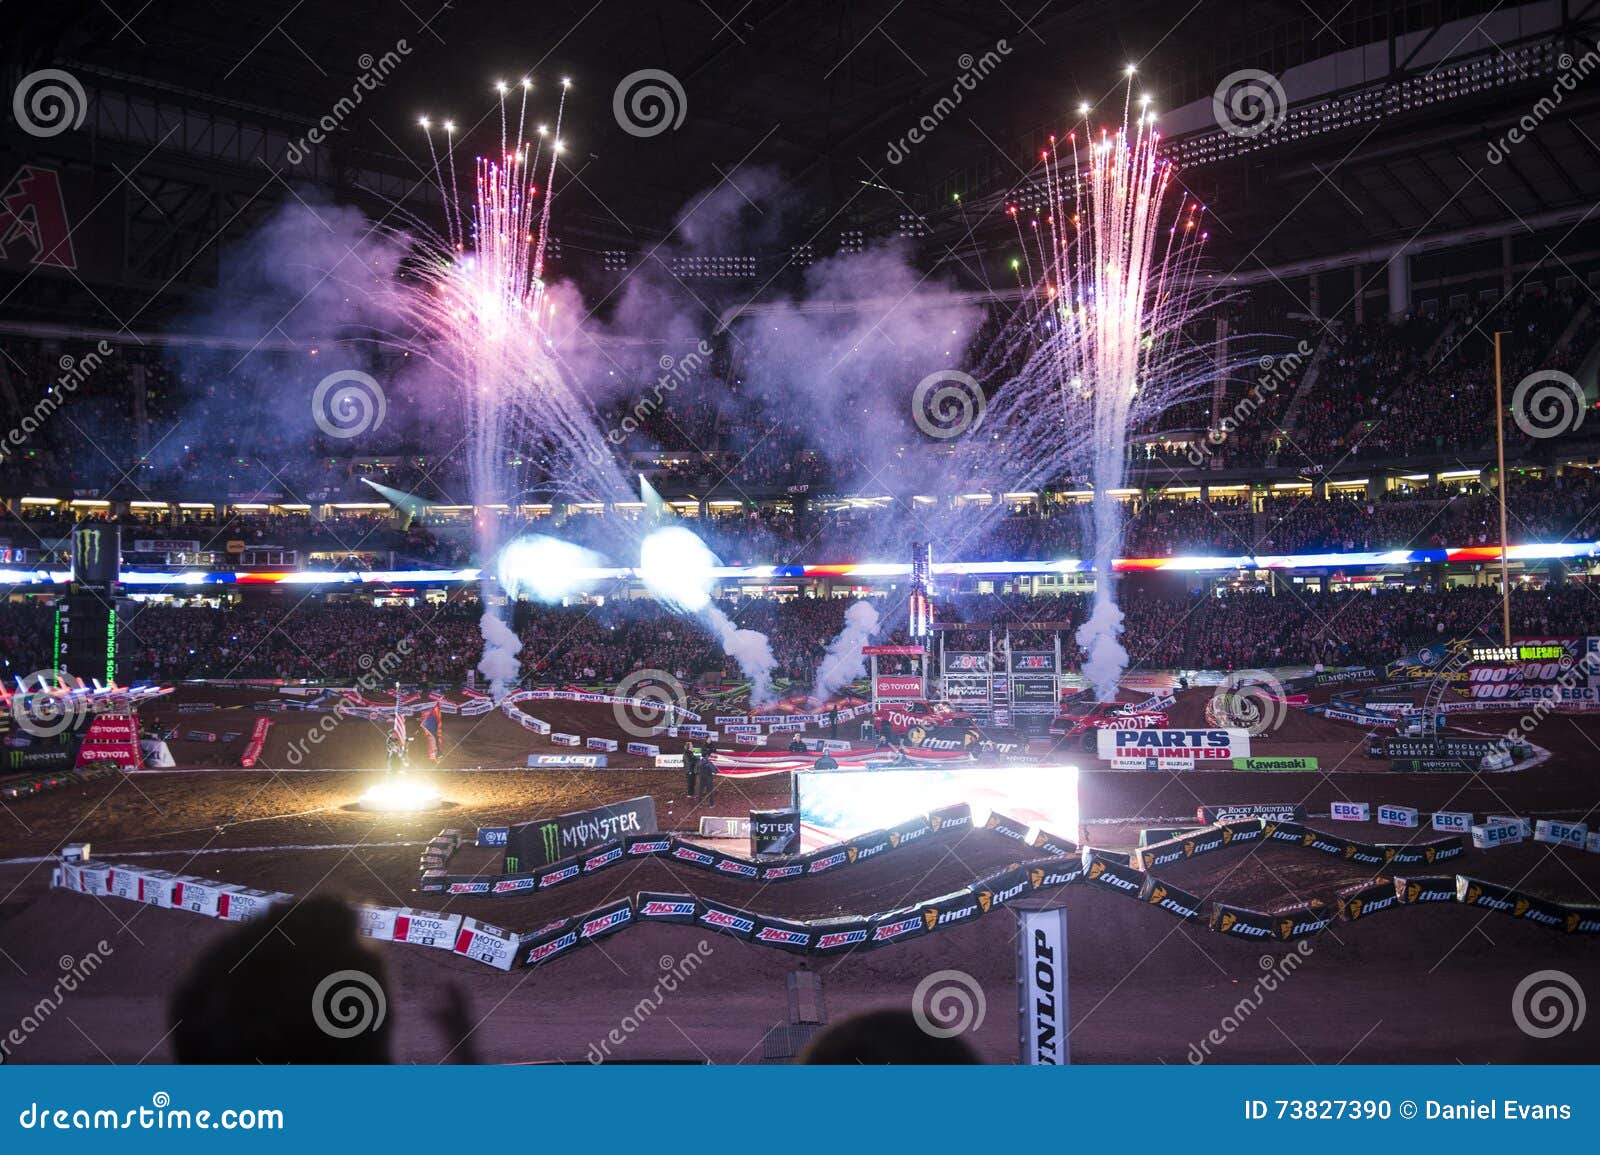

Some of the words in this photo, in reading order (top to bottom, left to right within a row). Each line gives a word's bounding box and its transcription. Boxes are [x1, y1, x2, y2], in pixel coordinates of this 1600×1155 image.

[1472, 647, 1518, 655] NUCLEAR
[1469, 667, 1524, 682] 100%
[890, 682, 920, 690] TOYOTA
[1470, 683, 1524, 698] 100%
[1522, 687, 1554, 699] EBC
[1561, 687, 1594, 699] EBC
[921, 737, 961, 750] thor
[1116, 730, 1232, 747] PARTS
[96, 751, 130, 759] TOYOTA
[1116, 747, 1232, 759] UNLIMITED
[1246, 758, 1307, 770] Kawasaki
[1228, 805, 1252, 814] ROCKY
[1253, 804, 1294, 813] MOUNTAIN
[1334, 804, 1360, 815] EBC
[1380, 809, 1407, 821] EBC
[940, 813, 972, 830] thor
[1435, 815, 1463, 826] EBC
[900, 826, 930, 843] thor
[995, 824, 1026, 841] thor
[1231, 830, 1261, 841] thor
[1272, 830, 1302, 841] thor
[1488, 825, 1518, 841] EBC
[1551, 825, 1581, 842] EBC
[628, 840, 671, 855] AMSOIL
[857, 842, 888, 860] thor
[1194, 840, 1222, 853] thor
[1311, 839, 1341, 854] thor
[1435, 846, 1463, 860] thor
[583, 847, 623, 871] AMSOIL
[672, 846, 714, 865] AMSOIL
[808, 851, 847, 872] AMSOIL
[1154, 851, 1183, 865] thor
[1353, 852, 1382, 864] thor
[1393, 851, 1423, 862] thor
[715, 859, 757, 876] AMSOIL
[762, 865, 803, 879] AMSOIL
[539, 864, 580, 888] AMSOIL
[1042, 869, 1083, 886] thor
[1099, 872, 1140, 891] thor
[447, 882, 490, 893] AMSOIL
[492, 877, 535, 893] AMSOIL
[992, 879, 1028, 905] thor
[1418, 889, 1457, 901] thor
[1475, 894, 1515, 910] thor
[639, 901, 696, 916] AMSOIL
[1160, 898, 1199, 918] thor
[1361, 895, 1397, 914] thor
[700, 909, 755, 933] AMSOIL
[937, 904, 978, 925] thor
[1524, 908, 1563, 926] thor
[411, 919, 442, 929] MOTO:
[580, 908, 632, 938] AMSOIL
[872, 915, 923, 941] AMSOIL
[1231, 923, 1273, 937] thor
[1292, 918, 1331, 935] thor
[474, 933, 505, 950] MOTO:
[756, 926, 811, 946] AMSOIL
[815, 929, 867, 949] AMSOIL
[526, 931, 577, 965] AMSOIL
[1034, 929, 1057, 1066] UNLOP
